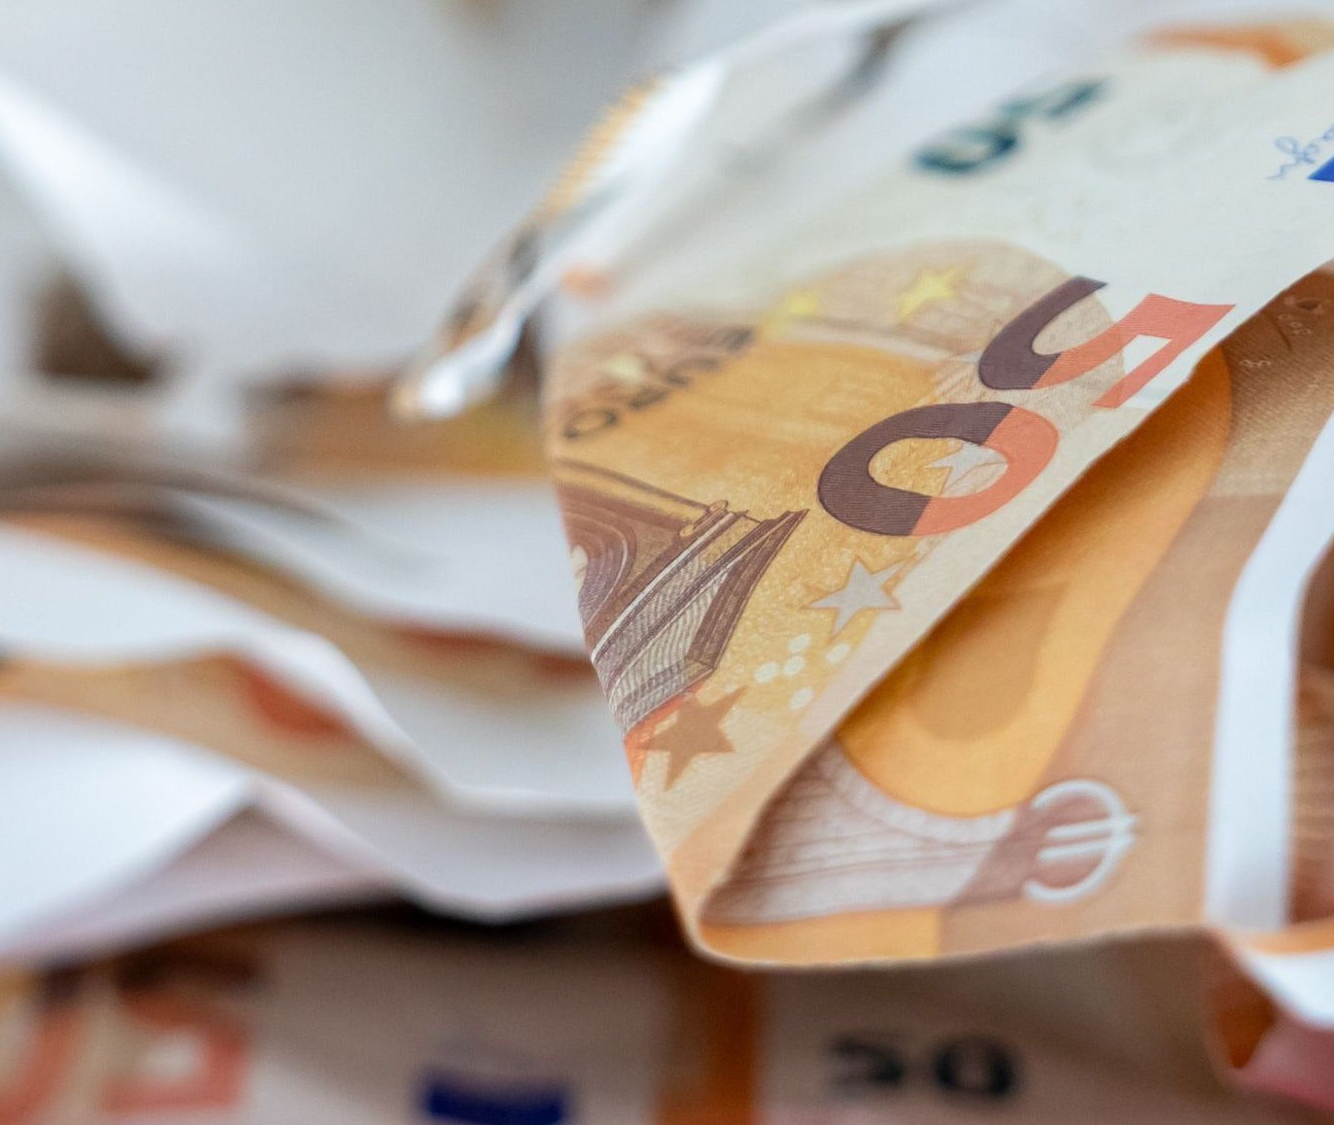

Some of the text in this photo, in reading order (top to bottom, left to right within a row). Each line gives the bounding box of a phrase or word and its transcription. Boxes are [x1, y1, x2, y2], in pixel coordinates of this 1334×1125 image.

[910, 75, 1107, 177] 50
[560, 323, 757, 441] EURO
[817, 275, 1236, 536] 50
[825, 1033, 1019, 1109] 50
